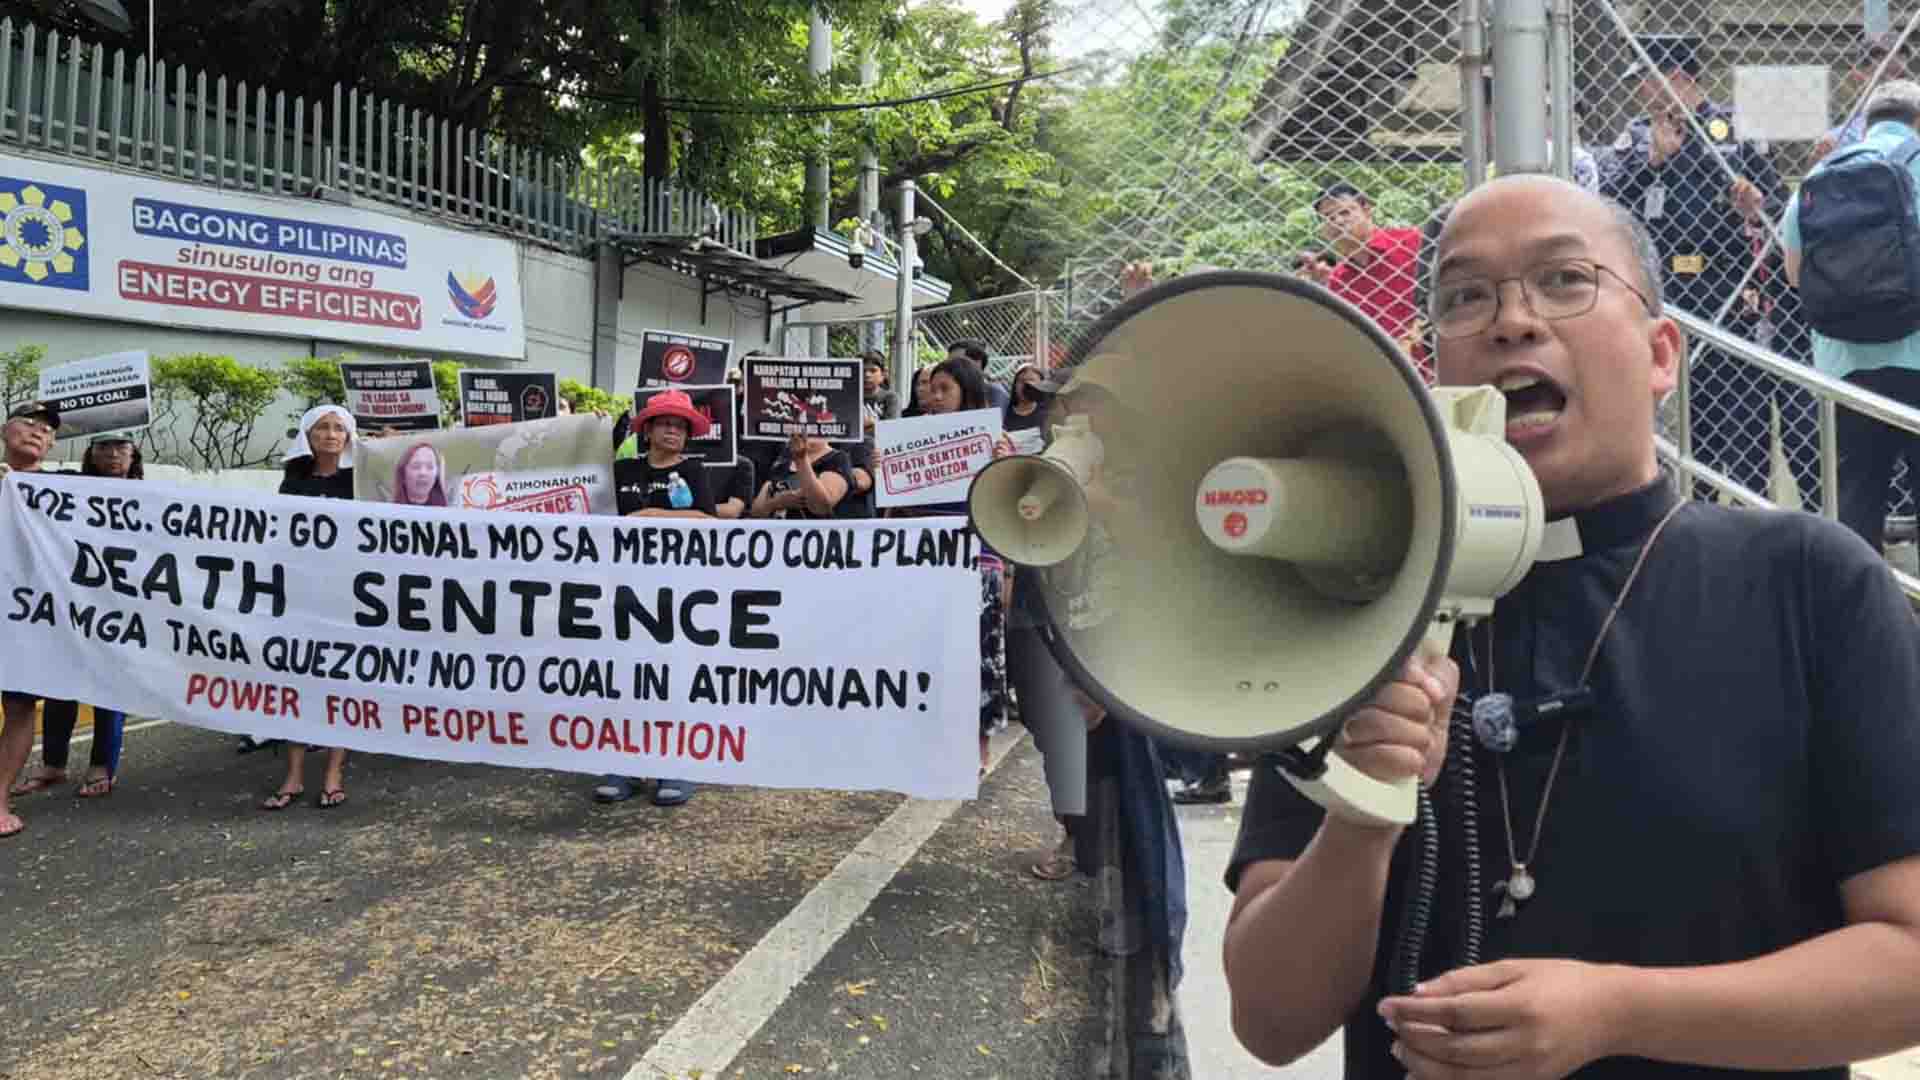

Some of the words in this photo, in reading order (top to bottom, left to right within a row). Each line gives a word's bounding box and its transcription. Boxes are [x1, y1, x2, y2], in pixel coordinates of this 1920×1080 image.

[134, 205, 269, 244] BAGONG
[279, 225, 408, 264] PILIPINAS
[177, 243, 321, 281] sinusulong
[328, 265, 375, 290] ang
[119, 266, 249, 305] ENERGY
[260, 285, 423, 325] EFFICIENCY
[60, 398, 77, 410] NO
[79, 395, 95, 407] TO
[96, 389, 129, 404] COAL!
[890, 454, 926, 475] DEATH
[928, 441, 984, 466] SENTENCE
[906, 437, 937, 450] COAL
[939, 426, 975, 441] PLANT
[505, 477, 569, 492] ATIMONAN
[572, 474, 598, 486] ONE
[905, 471, 922, 485] TO
[925, 460, 969, 482] QUEZON
[86, 495, 153, 533] SEC.
[161, 502, 278, 545] GARIN:
[289, 512, 338, 550] GO
[357, 517, 478, 559] SIGNAL
[487, 524, 544, 563] MO
[552, 525, 599, 564] SA
[613, 527, 774, 569] MERALCO
[782, 528, 862, 570] COAL
[70, 541, 287, 618] DEATH
[352, 572, 783, 650] SENTENCE
[7, 586, 56, 627] SA
[68, 601, 147, 649] MGA
[165, 618, 251, 665] TAGA
[262, 637, 420, 685] QUEZON!
[428, 650, 476, 691] NO
[485, 653, 526, 693] TO
[538, 656, 621, 700] COAL
[633, 663, 670, 701] IN
[186, 673, 302, 719] POWER
[326, 695, 382, 729] FOR
[402, 703, 529, 745] PEOPLE
[549, 713, 746, 762] COALITION
